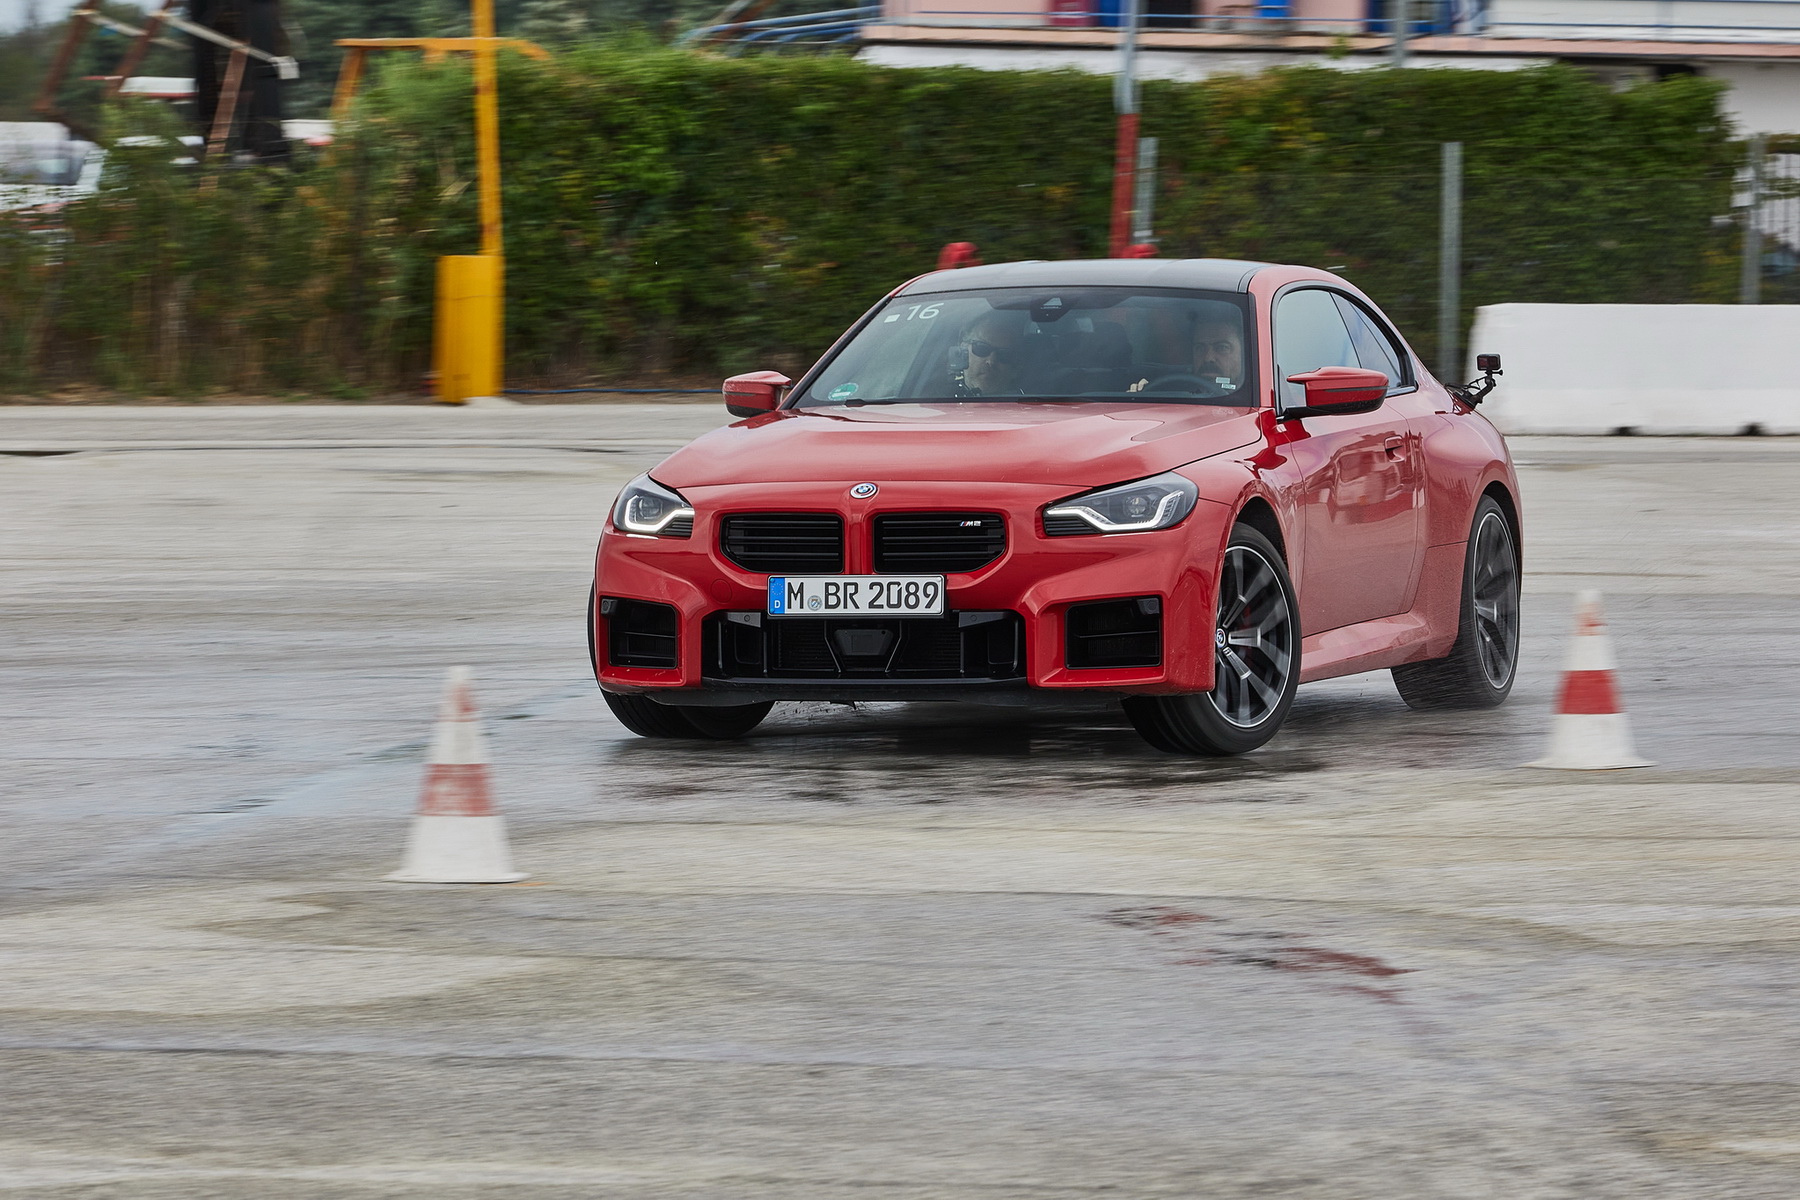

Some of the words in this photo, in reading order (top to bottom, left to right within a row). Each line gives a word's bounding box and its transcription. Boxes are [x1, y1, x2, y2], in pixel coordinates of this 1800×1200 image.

[907, 303, 945, 321] 16
[787, 581, 804, 609] M
[824, 581, 860, 609] BR
[868, 581, 939, 609] 2089
[774, 600, 781, 609] D
